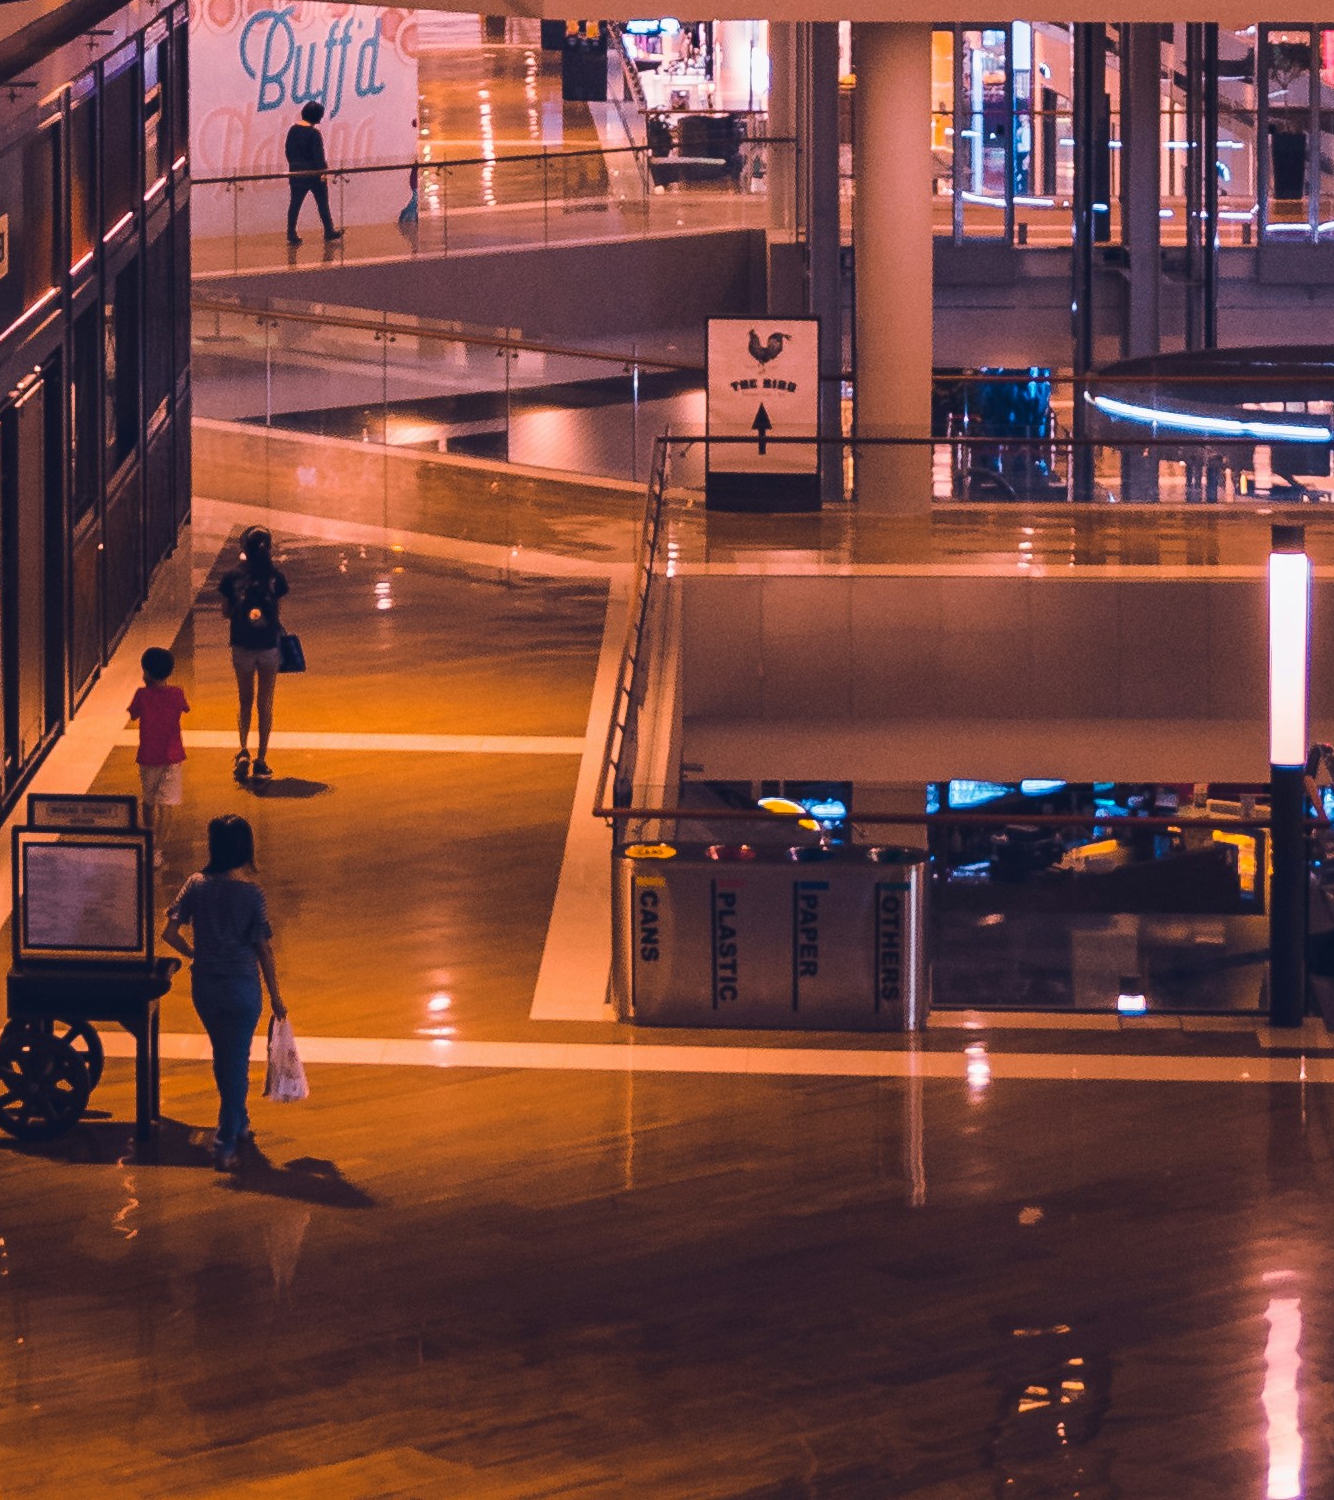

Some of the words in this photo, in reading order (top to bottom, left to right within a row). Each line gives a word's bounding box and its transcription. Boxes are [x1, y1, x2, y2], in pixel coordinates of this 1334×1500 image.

[239, 5, 386, 120] Buff'd
[730, 378, 758, 392] THE
[763, 378, 797, 393] BIRD
[640, 890, 660, 962] CANS
[718, 892, 738, 1001] PLASTIC
[799, 895, 819, 978] PAPER
[880, 896, 900, 1001] OTHERS
